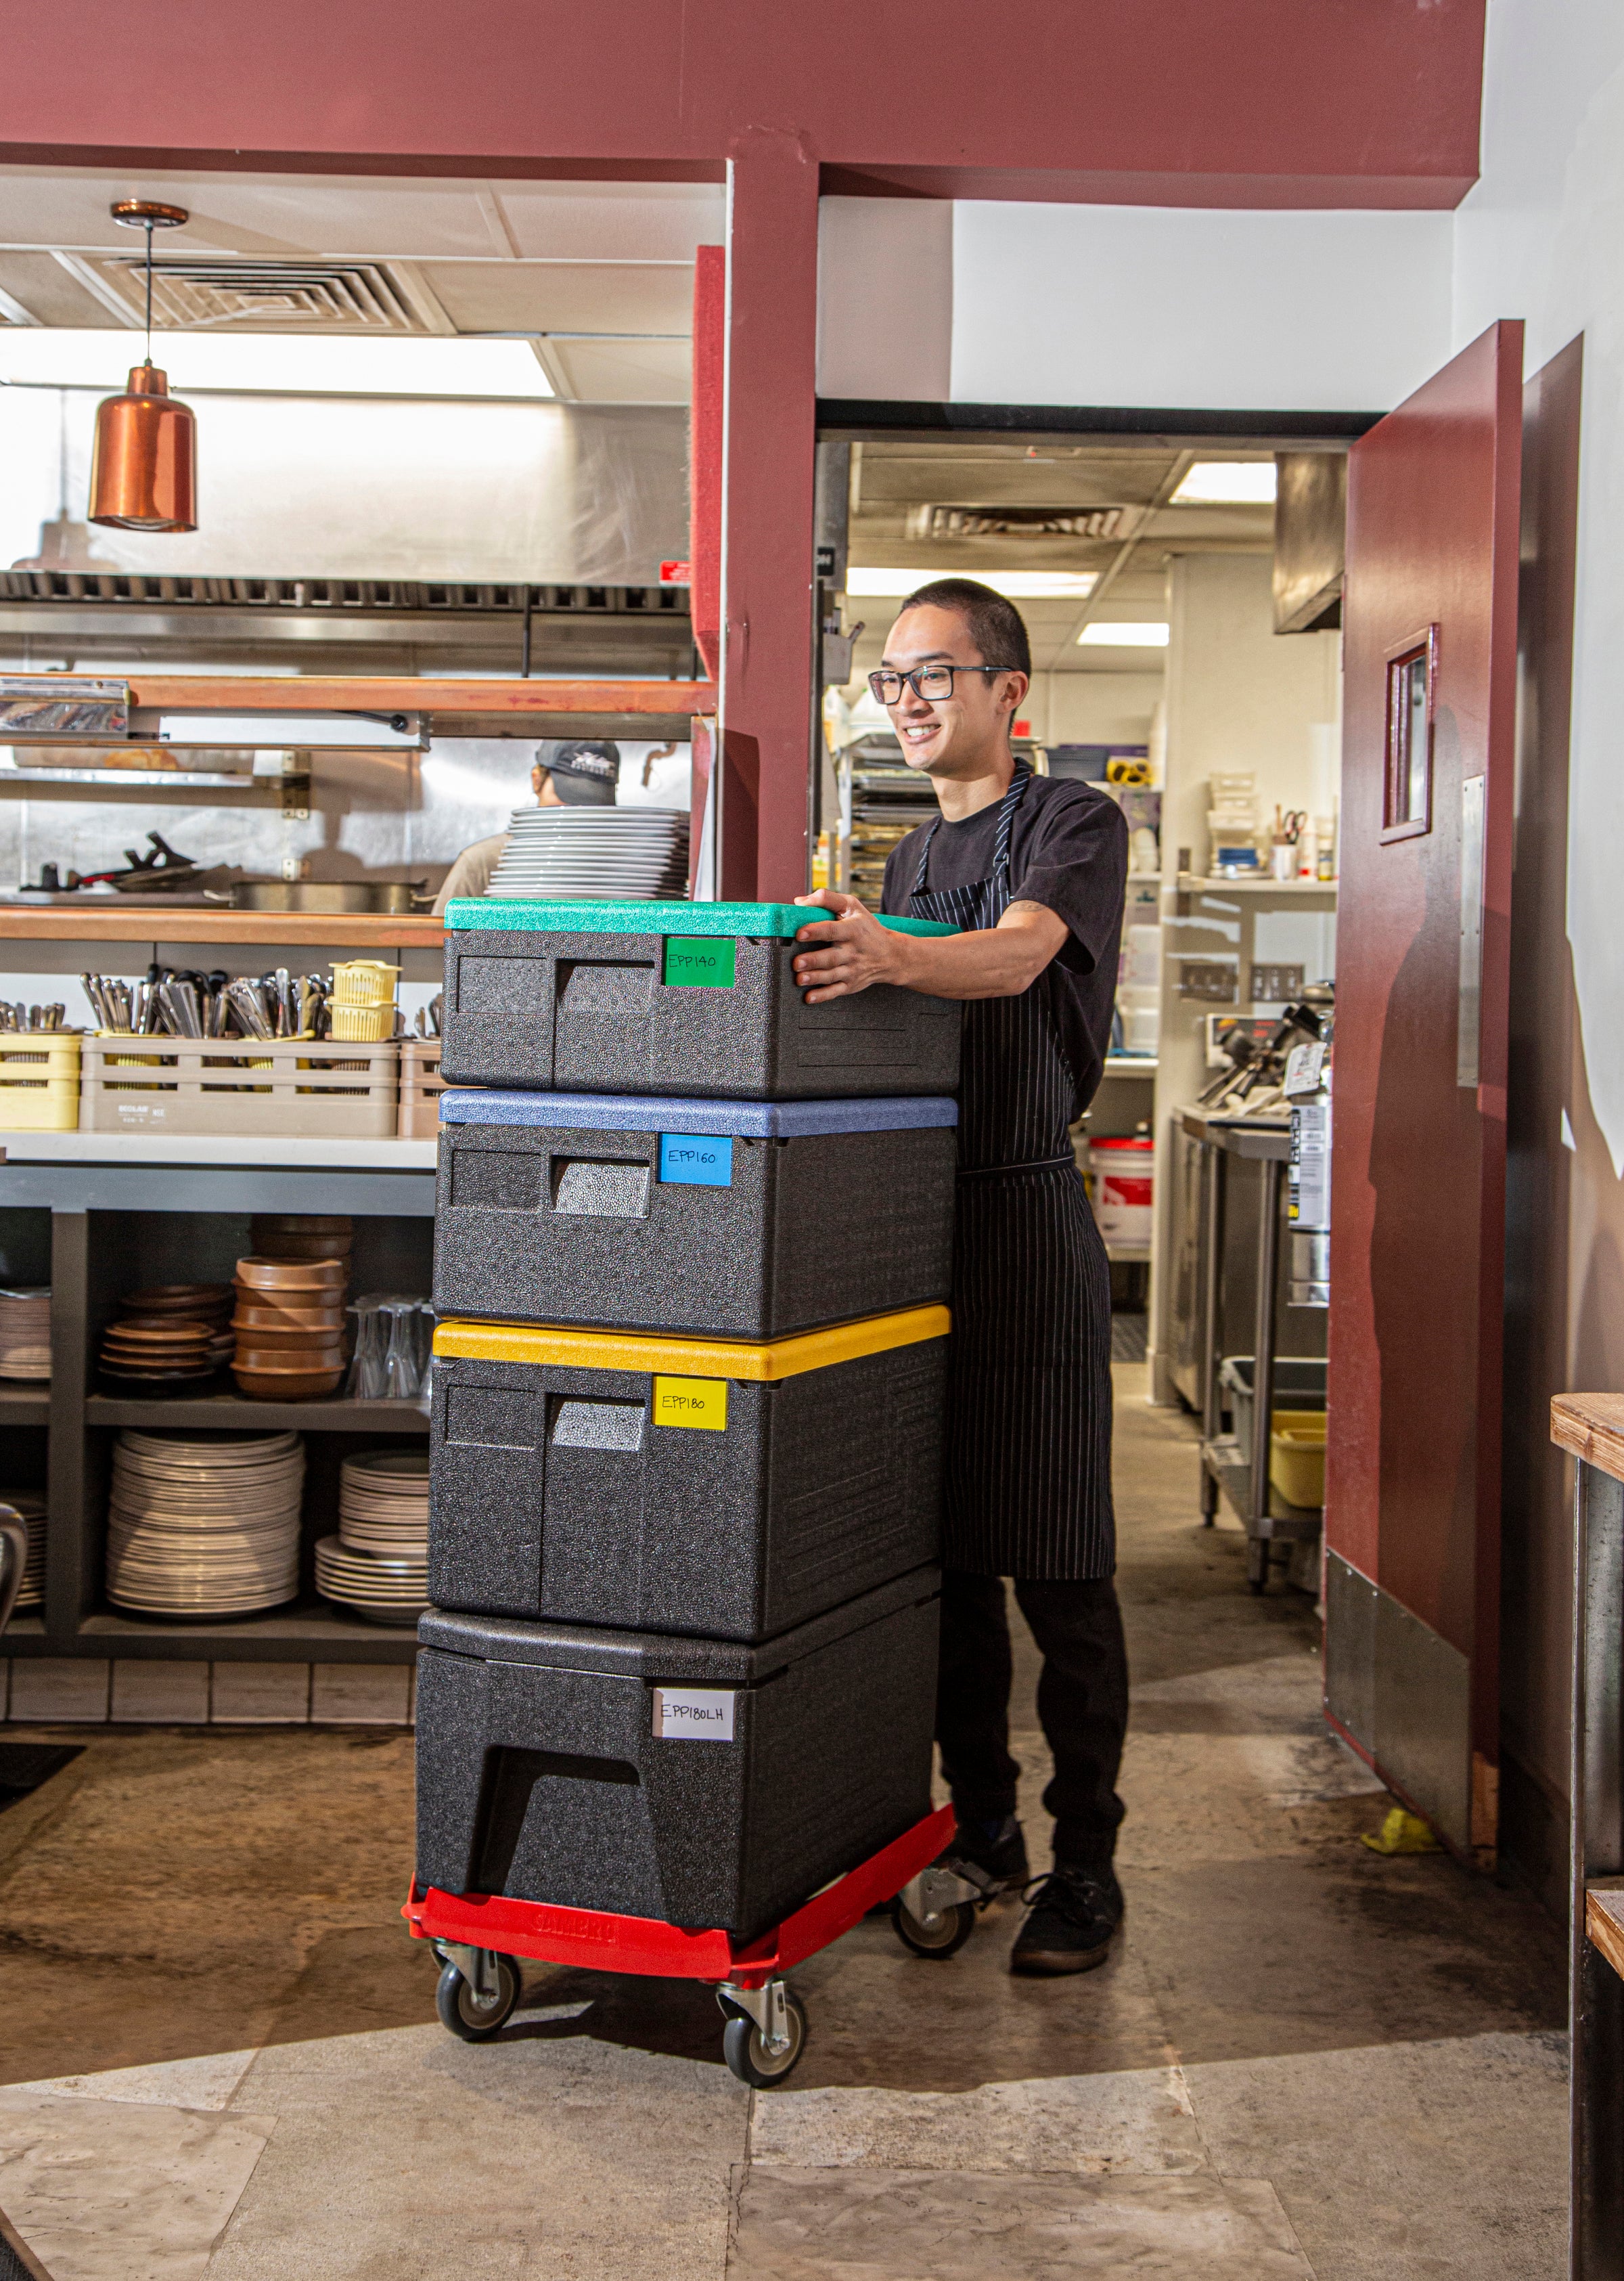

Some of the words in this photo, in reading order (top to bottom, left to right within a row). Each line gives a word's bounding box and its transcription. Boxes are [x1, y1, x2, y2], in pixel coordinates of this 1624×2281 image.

[669, 954, 716, 967] EPP140
[668, 1150, 716, 1163] EPP160
[662, 1396, 705, 1409] EPP180
[660, 1704, 723, 1721] EPP180LH
